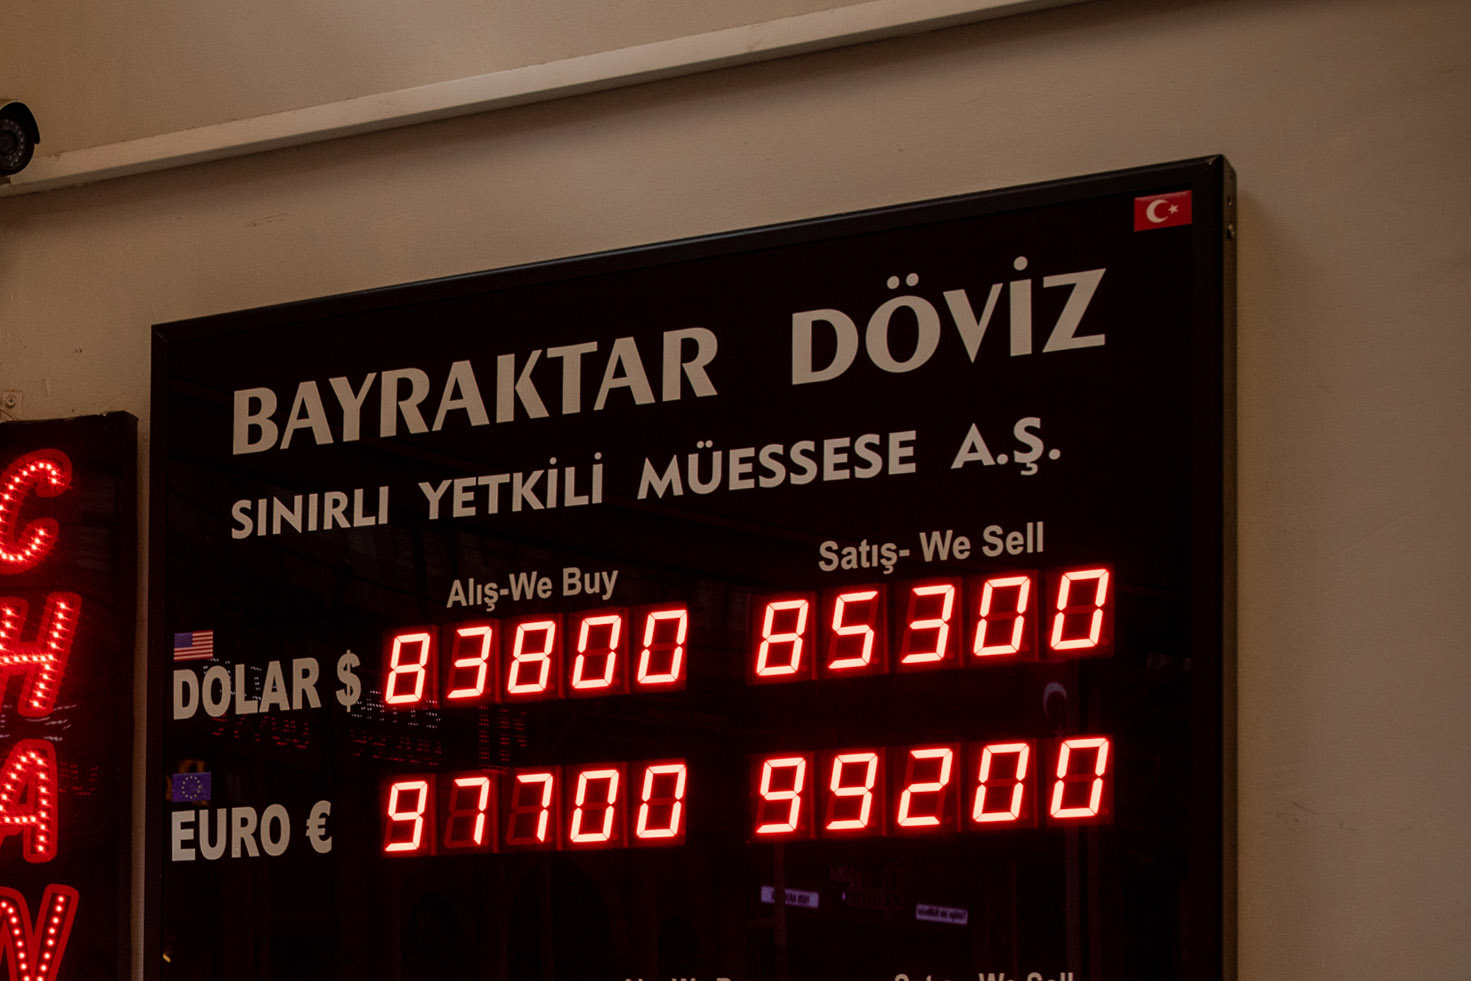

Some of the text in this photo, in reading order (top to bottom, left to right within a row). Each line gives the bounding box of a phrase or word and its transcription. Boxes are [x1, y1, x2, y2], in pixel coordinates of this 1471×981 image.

[231, 256, 1107, 457] BAYRAKTAR DÖVİZ
[232, 416, 1062, 538] SINIRLI YETKİLİ MÜESSESE A.Ş.
[564, 568, 617, 599] Buy
[920, 530, 970, 561] We
[983, 522, 1043, 556] Sell
[384, 609, 688, 704] 83800
[756, 568, 1109, 676] 85300
[173, 656, 322, 720] DOLAR
[337, 650, 361, 716] $
[172, 801, 331, 861] EURO €
[386, 764, 686, 851] 97700
[758, 738, 1108, 833] 99200
